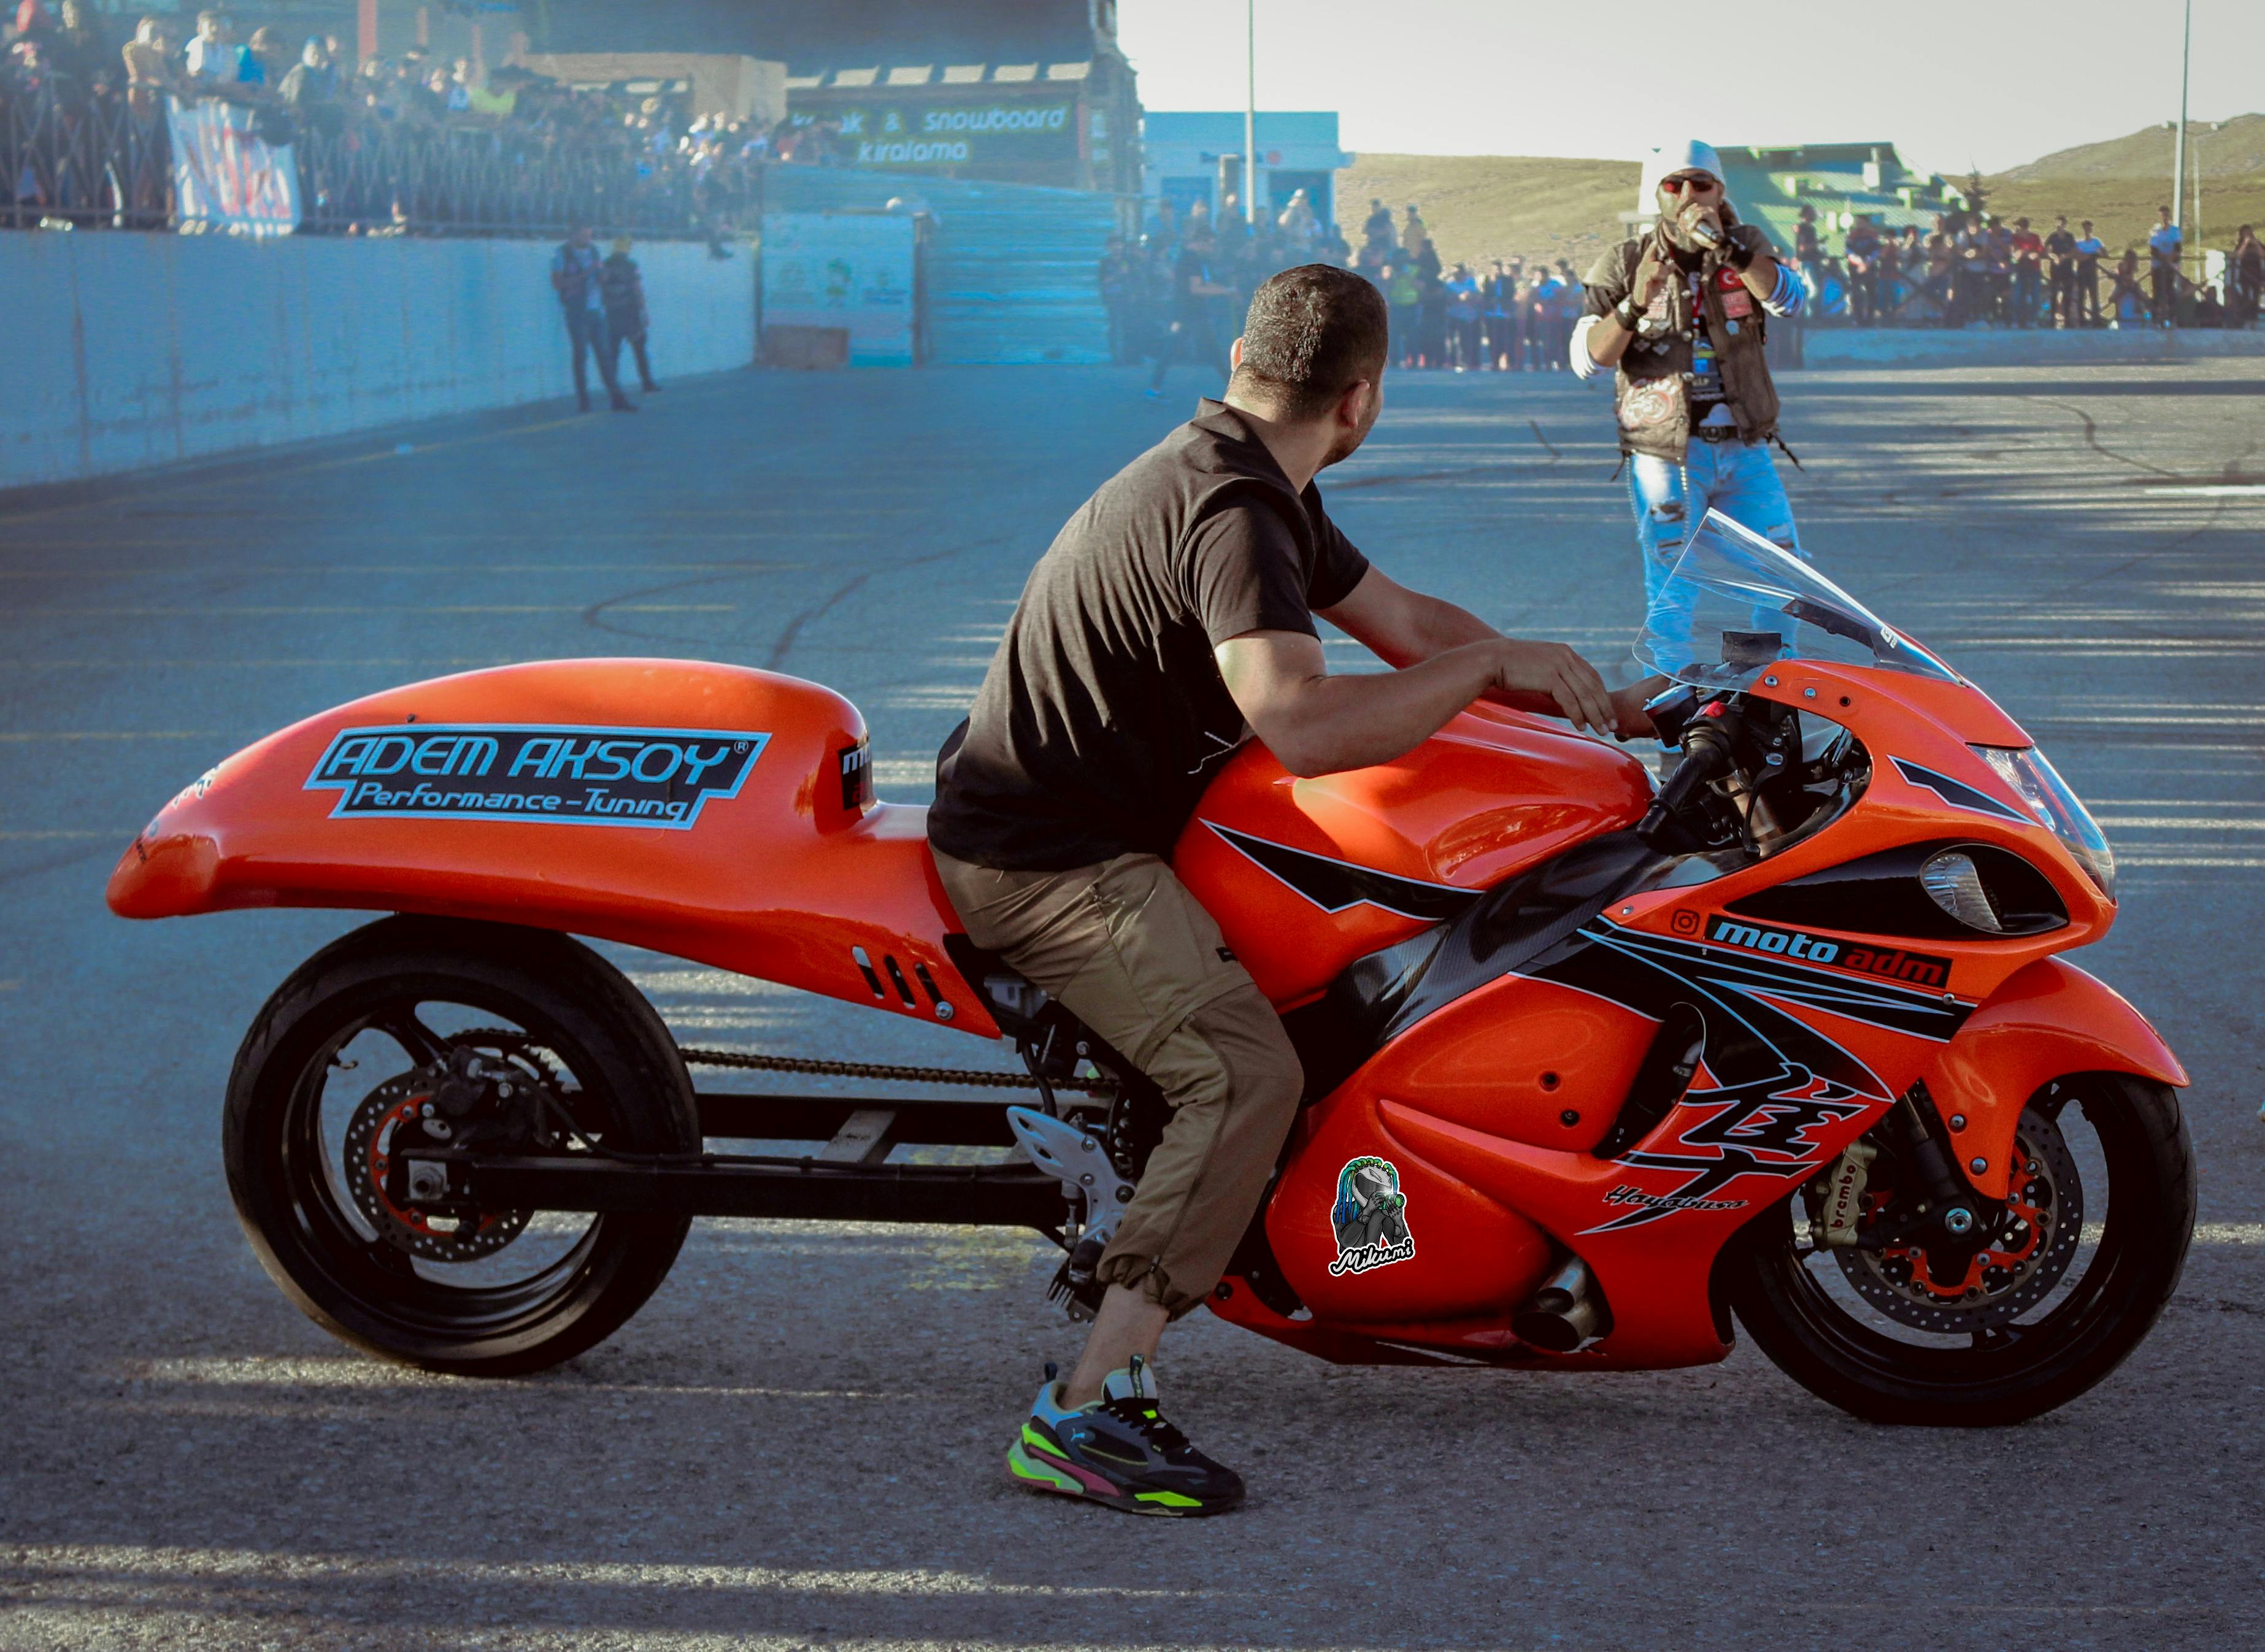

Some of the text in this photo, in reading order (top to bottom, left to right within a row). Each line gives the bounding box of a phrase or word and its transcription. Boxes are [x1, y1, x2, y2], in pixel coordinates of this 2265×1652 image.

[884, 113, 900, 133] &
[923, 106, 1067, 132] snowboard
[858, 138, 968, 163] kiralama
[324, 736, 497, 777] ADEM
[1713, 921, 1944, 985] moto adm
[1602, 1184, 1750, 1211] Hayabusa
[1830, 1165, 1856, 1227] brembo
